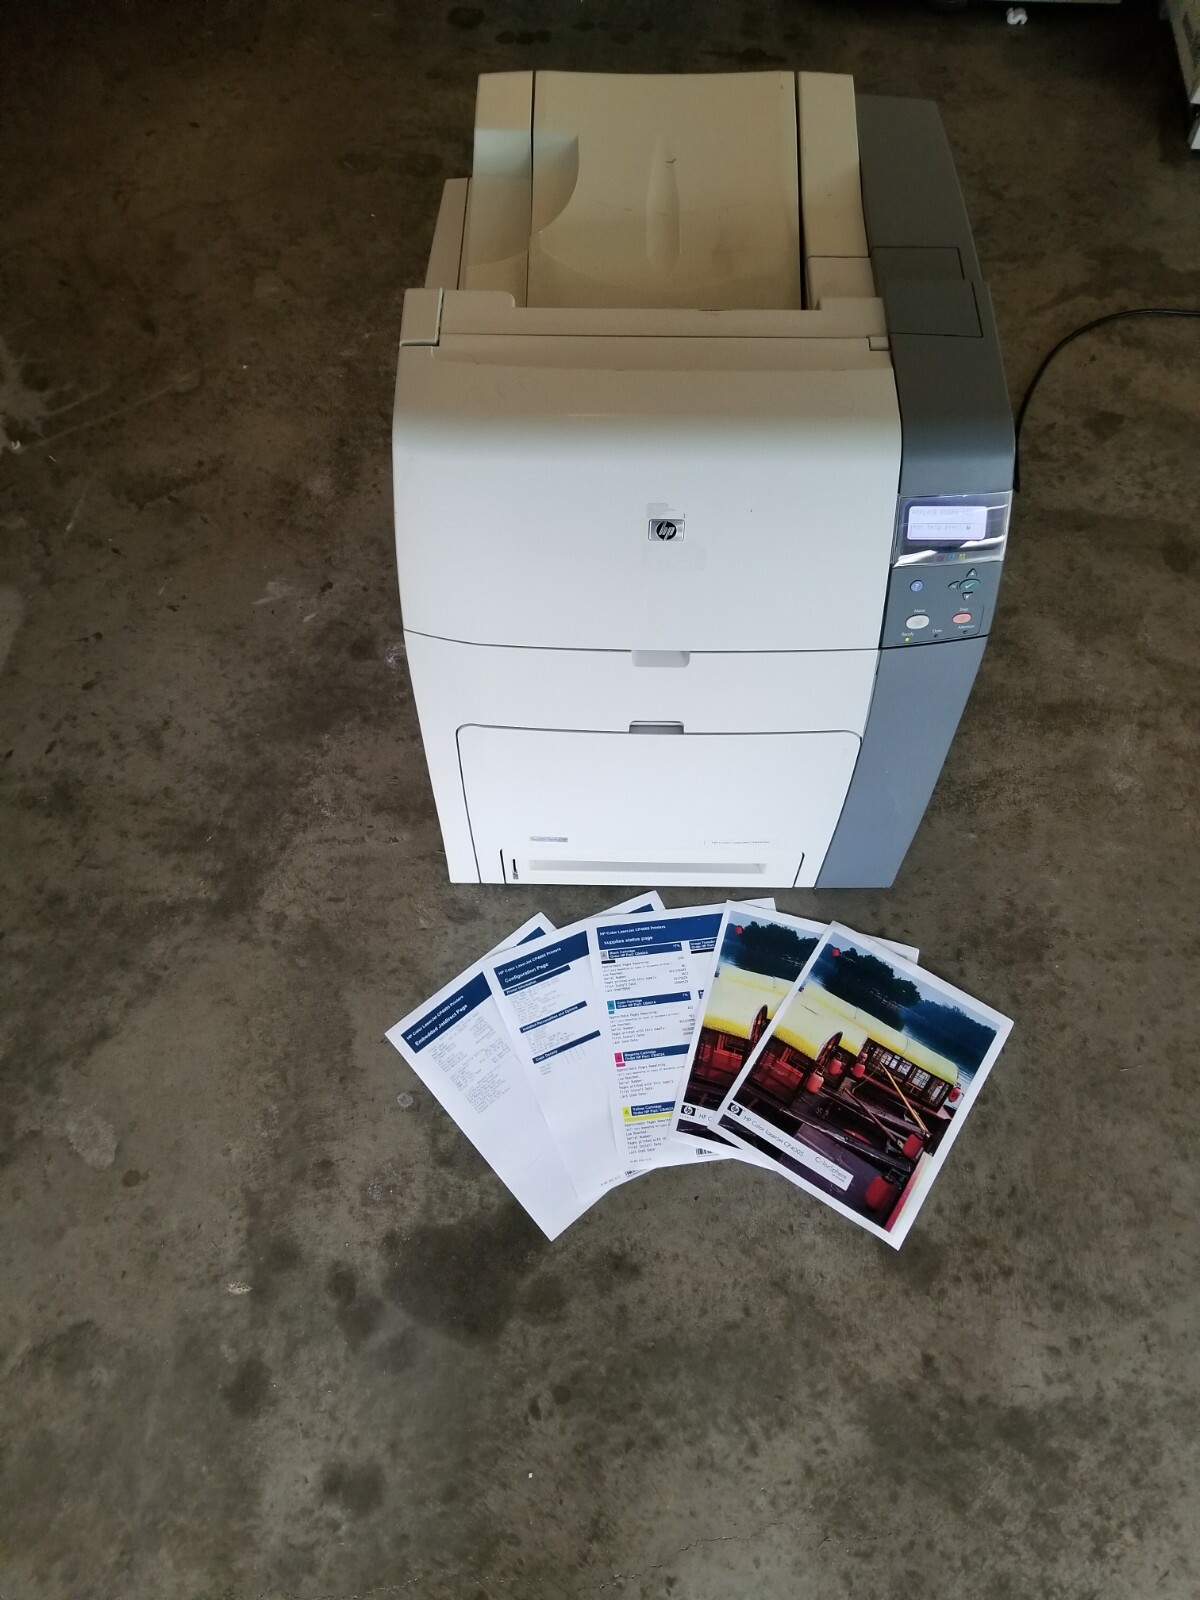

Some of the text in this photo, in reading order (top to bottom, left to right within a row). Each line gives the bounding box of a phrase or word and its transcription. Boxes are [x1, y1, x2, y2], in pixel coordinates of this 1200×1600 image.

[504, 967, 536, 983] Configuration
[415, 1027, 438, 1046] Embedded
[456, 1004, 467, 1015] Page
[752, 1121, 765, 1131] Color
[783, 1141, 804, 1157] CP4005
